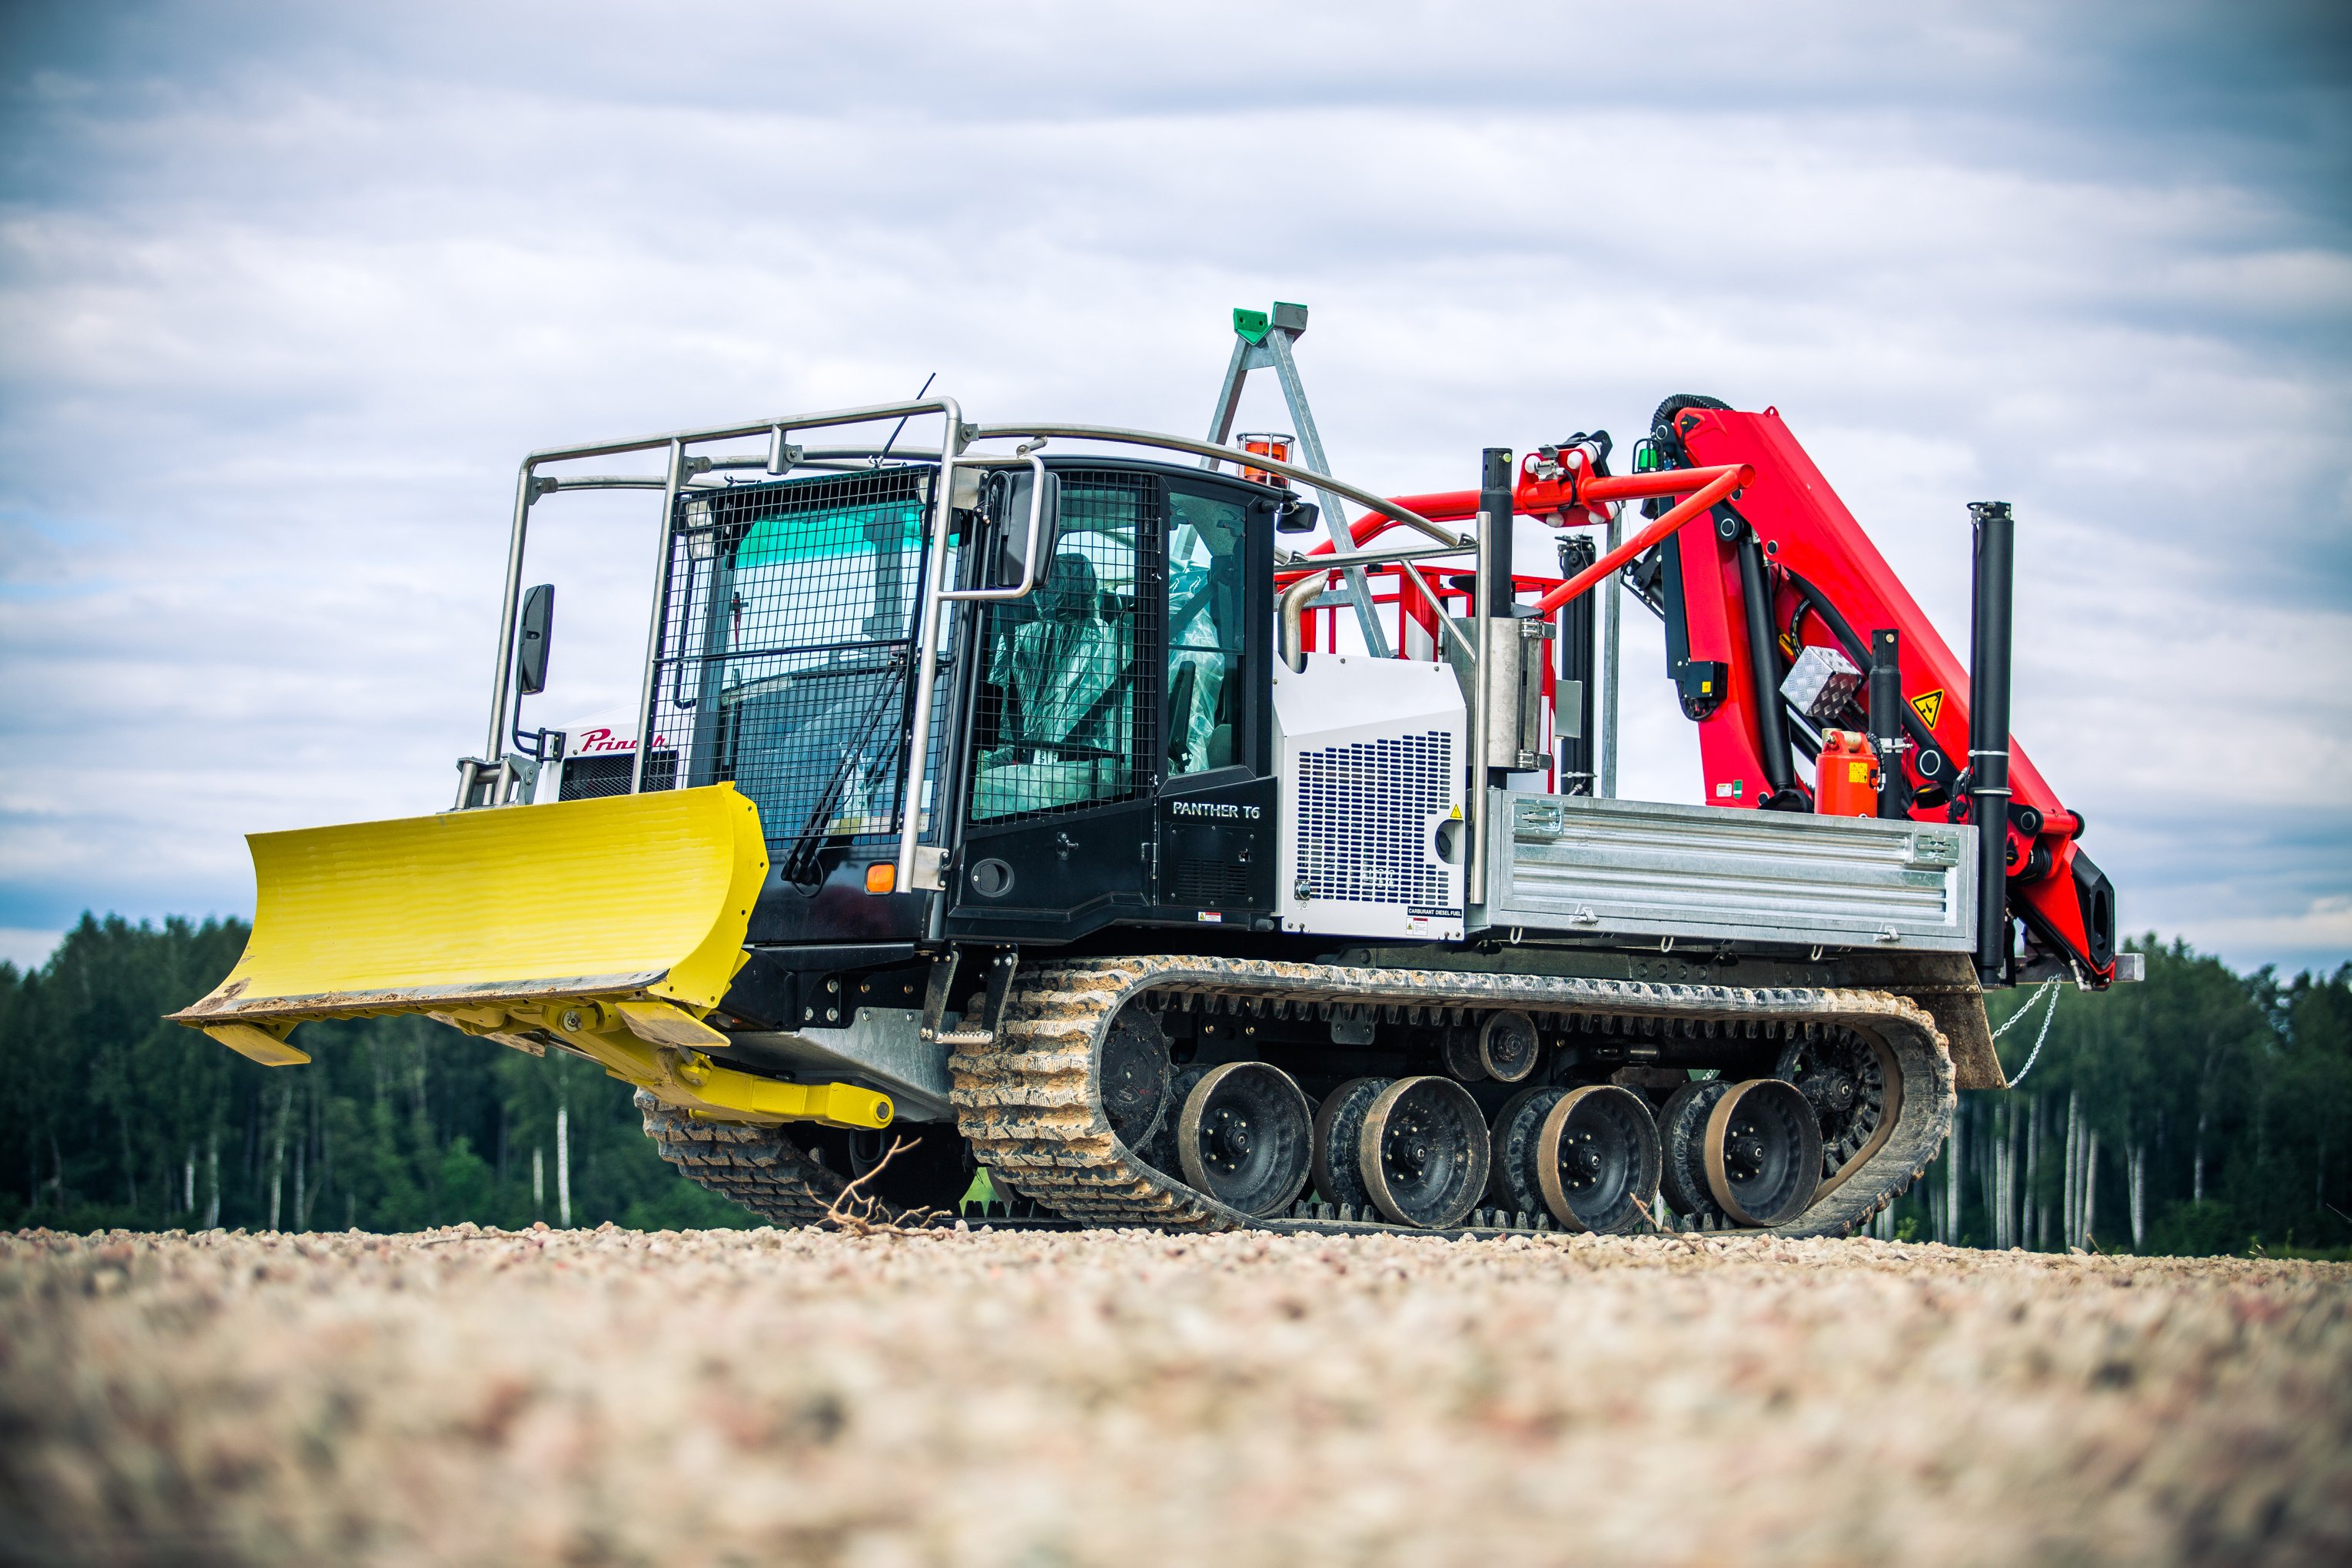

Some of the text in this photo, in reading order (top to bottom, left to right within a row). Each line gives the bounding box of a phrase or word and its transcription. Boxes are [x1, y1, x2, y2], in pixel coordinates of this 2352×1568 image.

[580, 729, 666, 752] Prinh
[1173, 802, 1261, 819] PANTHER T6
